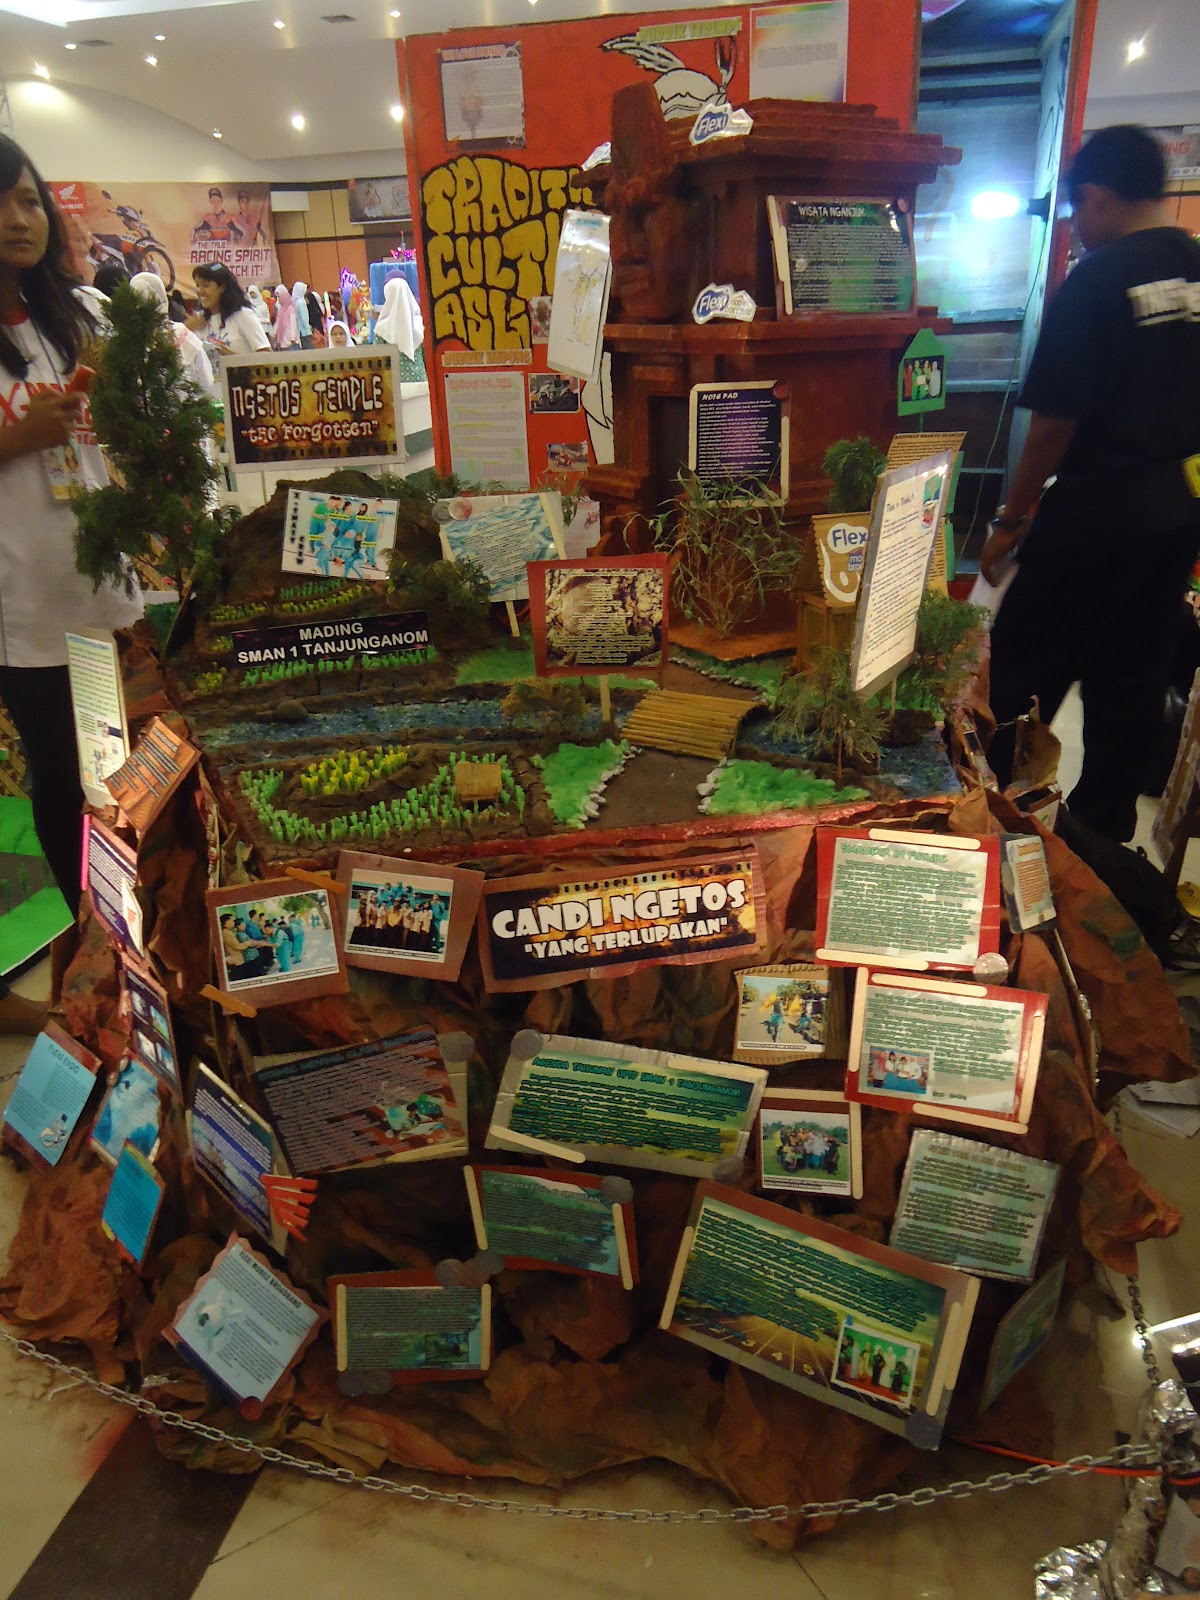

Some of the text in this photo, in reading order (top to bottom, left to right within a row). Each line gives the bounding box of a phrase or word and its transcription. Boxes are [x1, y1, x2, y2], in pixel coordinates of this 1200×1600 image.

[695, 111, 728, 137] Flexi
[422, 154, 596, 236] TRADIT
[798, 206, 865, 217] WISATA NGANJUK
[190, 248, 271, 263] RACING SPIRIT
[427, 212, 562, 301] CULT
[226, 265, 248, 276] TCH
[698, 288, 729, 314] Flexi
[231, 375, 383, 420] NGETOS TEMPLE
[722, 392, 738, 400] PAD
[299, 622, 363, 641] MADING
[237, 629, 429, 665] SMAN 1 TANJUNGANOM
[492, 879, 747, 940] CANDI NGETOS
[525, 916, 728, 960] "YANG TERLUPAKAN"
[531, 1056, 569, 1071] AGENDA
[640, 1071, 667, 1085] SMAN
